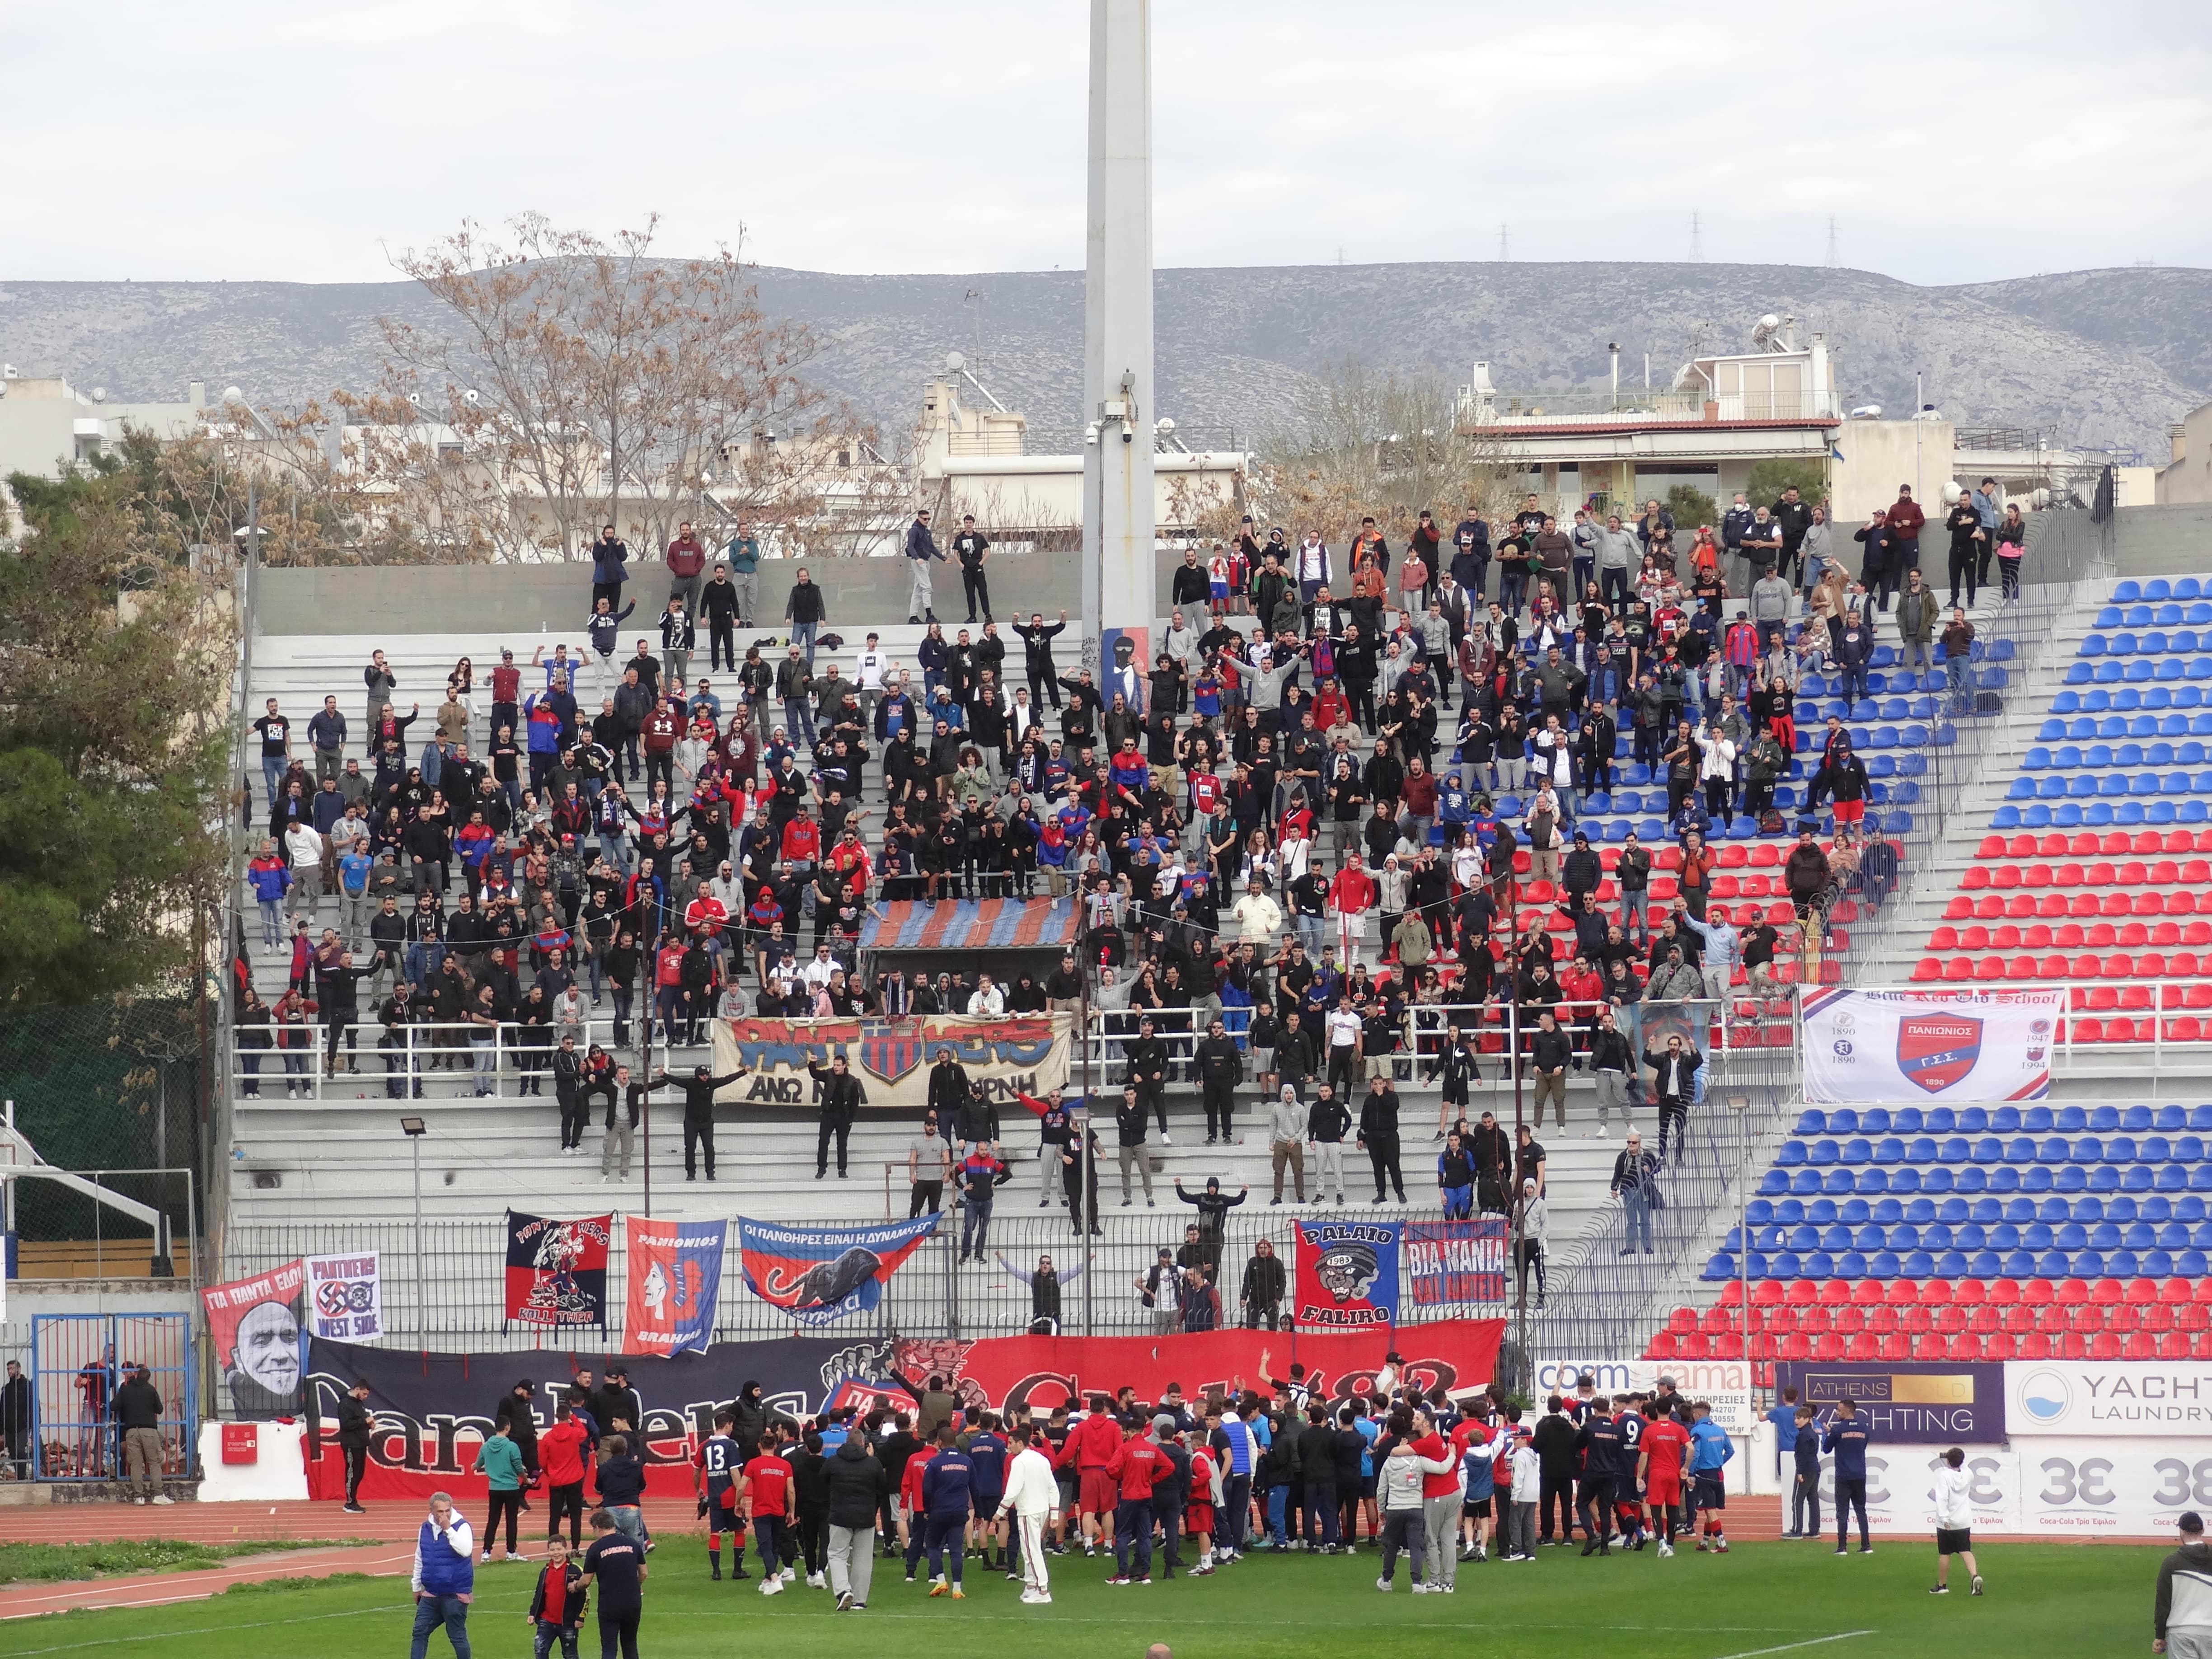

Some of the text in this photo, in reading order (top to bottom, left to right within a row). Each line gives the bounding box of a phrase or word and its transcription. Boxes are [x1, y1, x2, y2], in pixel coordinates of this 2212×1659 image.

[1995, 994, 2056, 1005] School
[1832, 1027, 1856, 1036] 1890
[1908, 1025, 1972, 1036] ΠΑΝΙΩΝΙΟΣ
[1832, 1056, 1855, 1064] 1890
[1921, 1052, 1958, 1067] Γ.Σ.Σ.
[745, 1075, 802, 1104] ΑΝΩ
[578, 1222, 609, 1246] HERS
[637, 1233, 720, 1248] PANIONIOS
[745, 1224, 756, 1236] ΟΙ
[758, 1228, 822, 1245] ΠΑΝΘΗΡΕΣ
[824, 1233, 854, 1245] ΕΙΝΑΙ
[856, 1233, 865, 1244] Η
[1302, 1225, 1393, 1246] PALAIO
[311, 1256, 376, 1280] PANTHERS
[1330, 1257, 1350, 1265] 1983
[230, 1279, 273, 1306] ΠΑΝΤΑ
[1299, 1304, 1391, 1326] FALIRO
[318, 1314, 380, 1338] WEST SIDE
[1813, 1382, 1888, 1396] ATHENS
[1289, 1388, 1309, 1411] 20
[1693, 1395, 1746, 1404] ΥΠΗΡΕΣΙΕΣ
[1626, 1420, 1639, 1443] 9
[706, 1444, 725, 1472] 13
[1978, 1516, 2003, 1525] Έψιλον
[2039, 1517, 2074, 1525] Coca-Cola
[2091, 1518, 2117, 1527] Έψιλον
